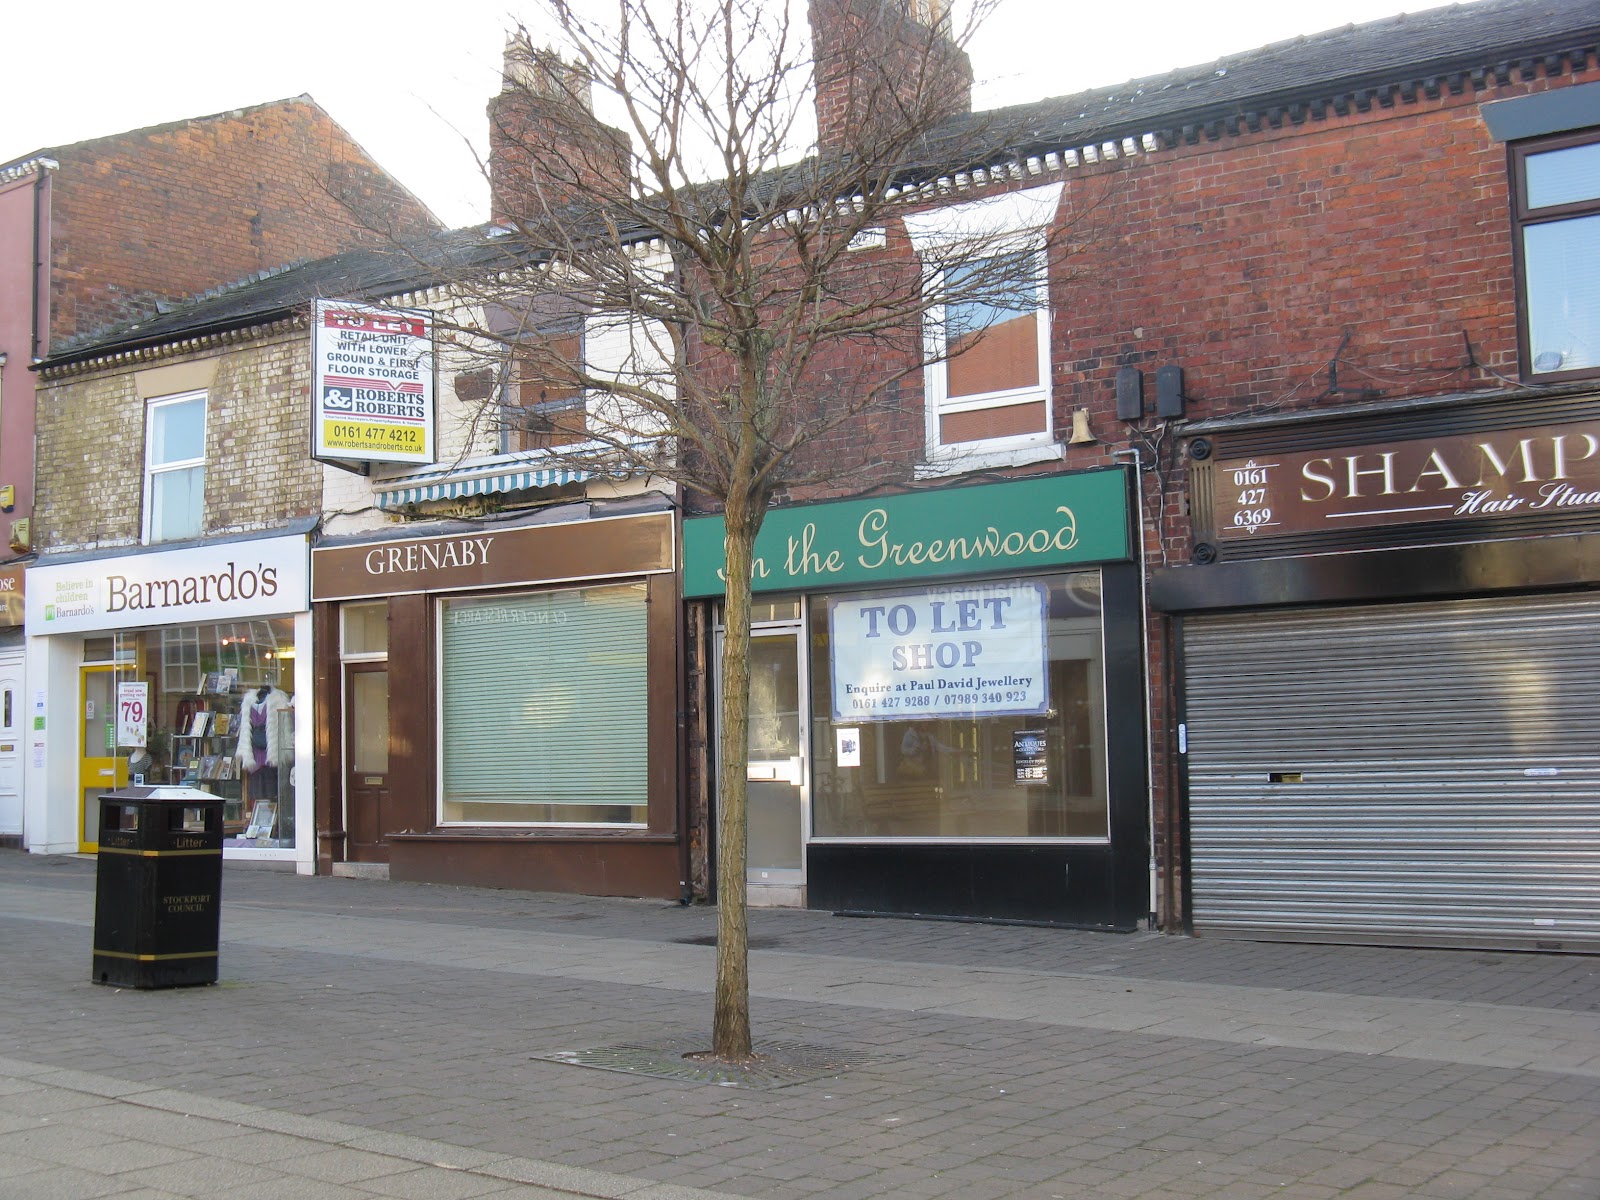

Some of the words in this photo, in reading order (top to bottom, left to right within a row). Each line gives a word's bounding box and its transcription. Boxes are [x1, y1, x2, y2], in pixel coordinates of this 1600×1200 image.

[333, 313, 365, 327] TO
[340, 330, 379, 342] RETAIL
[380, 334, 408, 345] UNIT
[337, 341, 366, 352] WITH
[369, 345, 407, 356] LOWER
[327, 352, 374, 365] GROUND
[378, 357, 386, 366] &
[389, 358, 420, 369] FIRST
[328, 364, 365, 375] FLOOR
[368, 368, 420, 380] STORAGE
[324, 389, 352, 409] &
[355, 401, 425, 418] ROBERTS
[355, 388, 425, 405] ROBERTS
[334, 425, 361, 438] 0161
[365, 427, 386, 440] 477
[389, 429, 416, 442] 4212
[327, 439, 423, 452] www.robertsandroberts.co.uk
[1300, 434, 1600, 502] SHAMP
[1234, 470, 1268, 486] 0161
[1237, 489, 1266, 506] 427
[1454, 490, 1526, 516] Hair
[1234, 508, 1272, 526] 6369
[717, 536, 771, 582] n
[783, 523, 845, 576] the
[858, 506, 1079, 569] Greenwood
[365, 538, 494, 575] GRENABY
[56, 581, 84, 591] Believe
[85, 578, 94, 589] in
[106, 562, 278, 613] Barnardo's
[56, 592, 88, 603] children
[57, 604, 94, 618] Barnardo's
[860, 603, 917, 638] TO
[929, 596, 1012, 634] LET
[892, 640, 983, 672] SHOP
[846, 684, 892, 696] Enquire
[895, 683, 907, 692] at
[910, 679, 935, 691] Paul
[937, 678, 973, 690] David
[975, 676, 1033, 691] Jewellery
[852, 698, 877, 709] 0161
[881, 697, 900, 708] 427
[904, 695, 930, 707] 9288
[934, 695, 940, 706] /
[944, 693, 979, 705] 07989
[982, 692, 1002, 704] 340
[1006, 690, 1027, 702] 923
[121, 701, 143, 723] 79
[1014, 740, 1047, 748] ANTIQUES
[176, 837, 205, 849] Litter
[163, 894, 212, 905] STOCKPORT
[168, 904, 205, 913] COUNCIL
